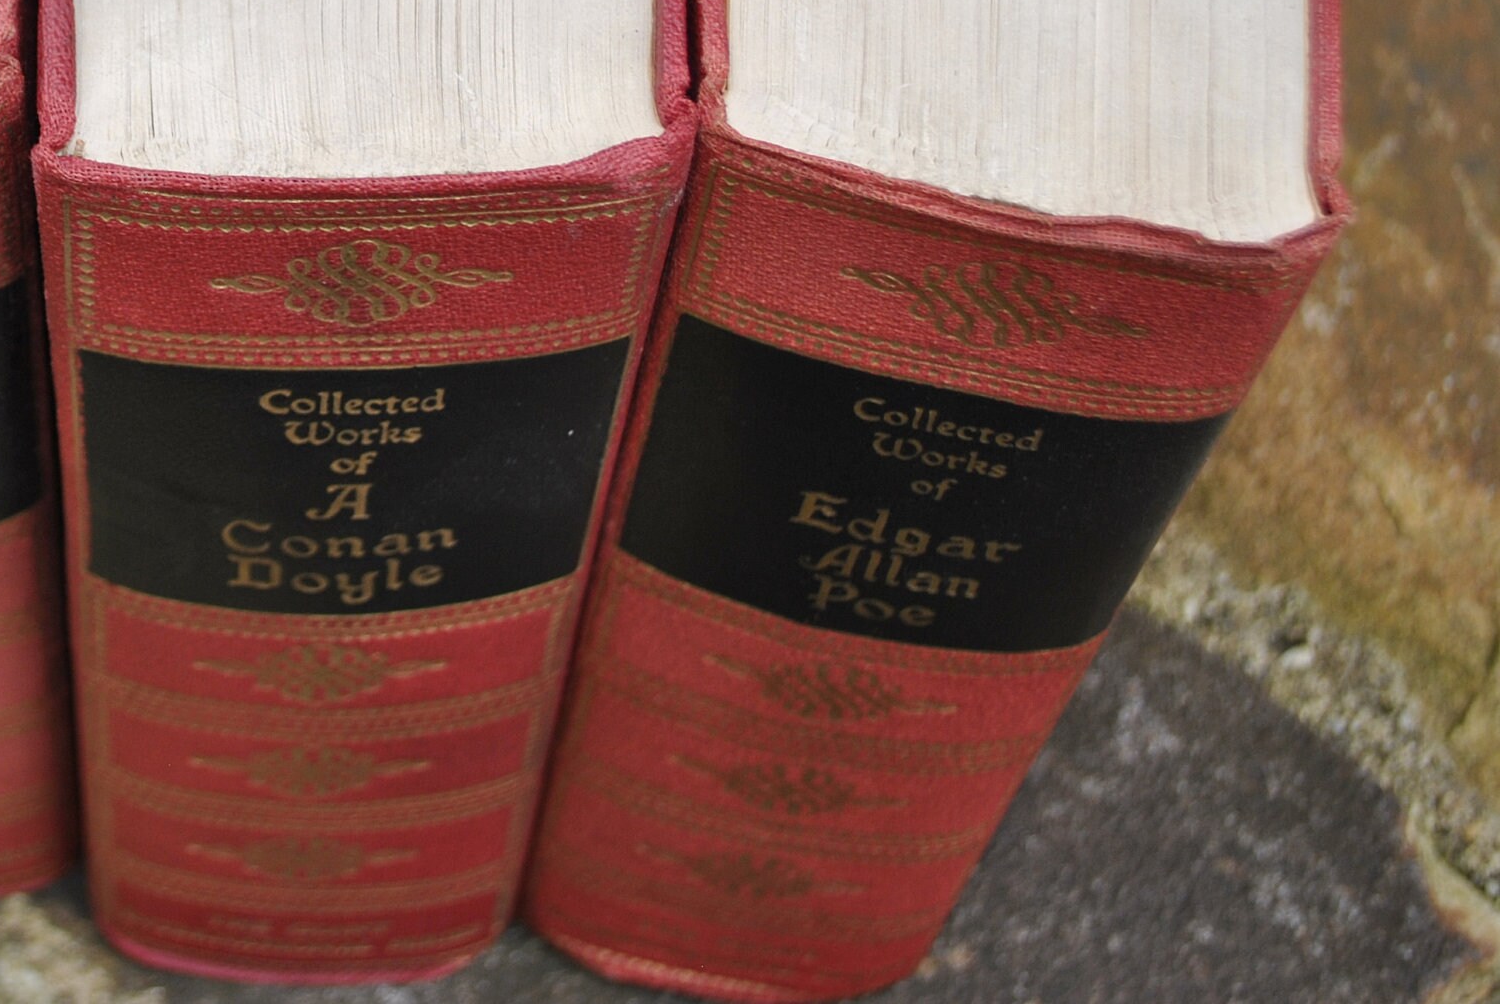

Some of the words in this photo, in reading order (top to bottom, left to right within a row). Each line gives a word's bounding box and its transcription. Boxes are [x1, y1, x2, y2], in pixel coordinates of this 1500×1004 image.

[259, 388, 446, 415] Collected
[284, 421, 423, 446] Works
[853, 397, 1043, 451] Collected
[329, 451, 378, 475] of
[873, 432, 1007, 478] Works
[305, 483, 373, 520] A
[911, 478, 958, 500] of
[221, 519, 459, 558] Conan
[789, 491, 1022, 563] Edgar
[227, 554, 443, 606] Doyle
[798, 544, 980, 599] Allan
[809, 574, 936, 627] Poe
